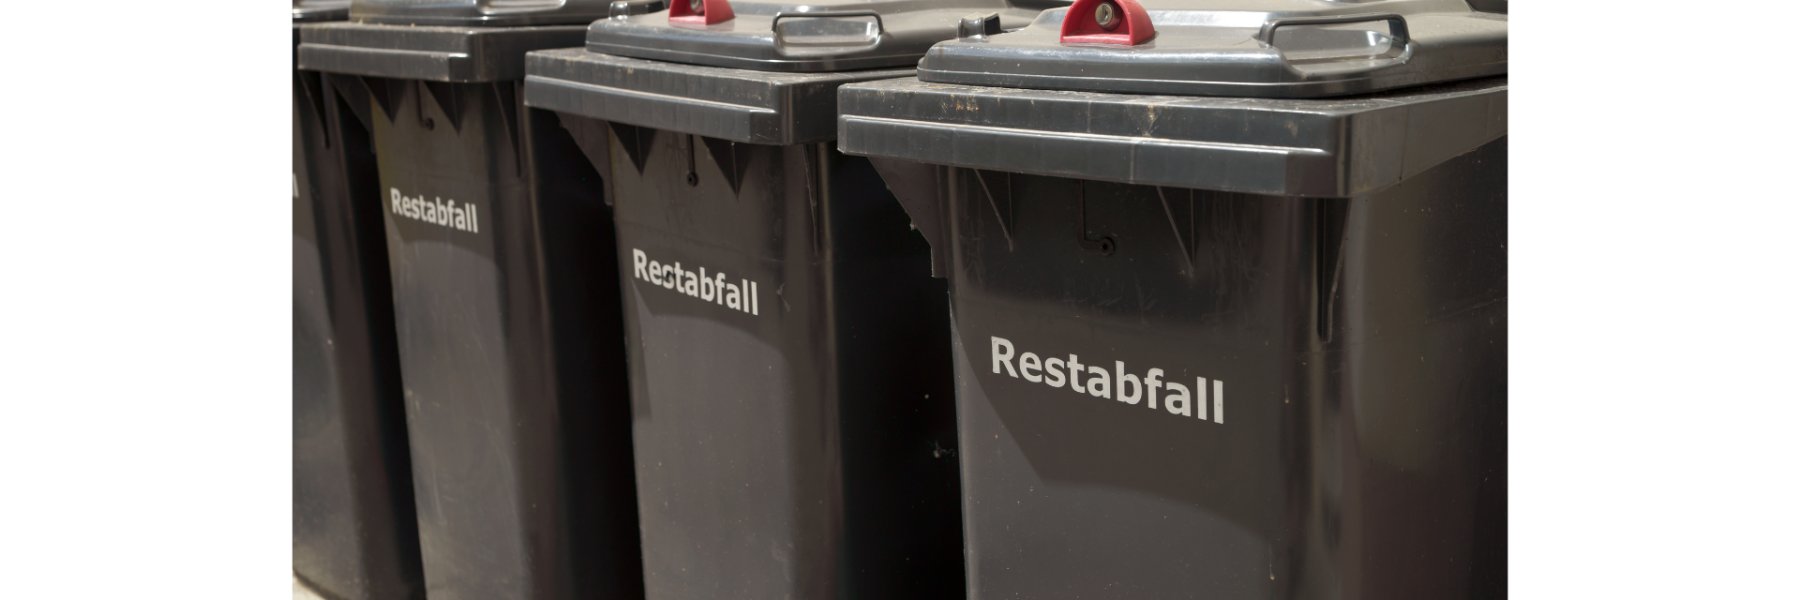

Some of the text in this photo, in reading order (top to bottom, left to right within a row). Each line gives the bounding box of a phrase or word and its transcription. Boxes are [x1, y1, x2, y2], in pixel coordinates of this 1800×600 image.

[391, 187, 478, 233] Restabfall
[633, 248, 758, 315] Restabfall
[991, 336, 1224, 424] Restabfall
